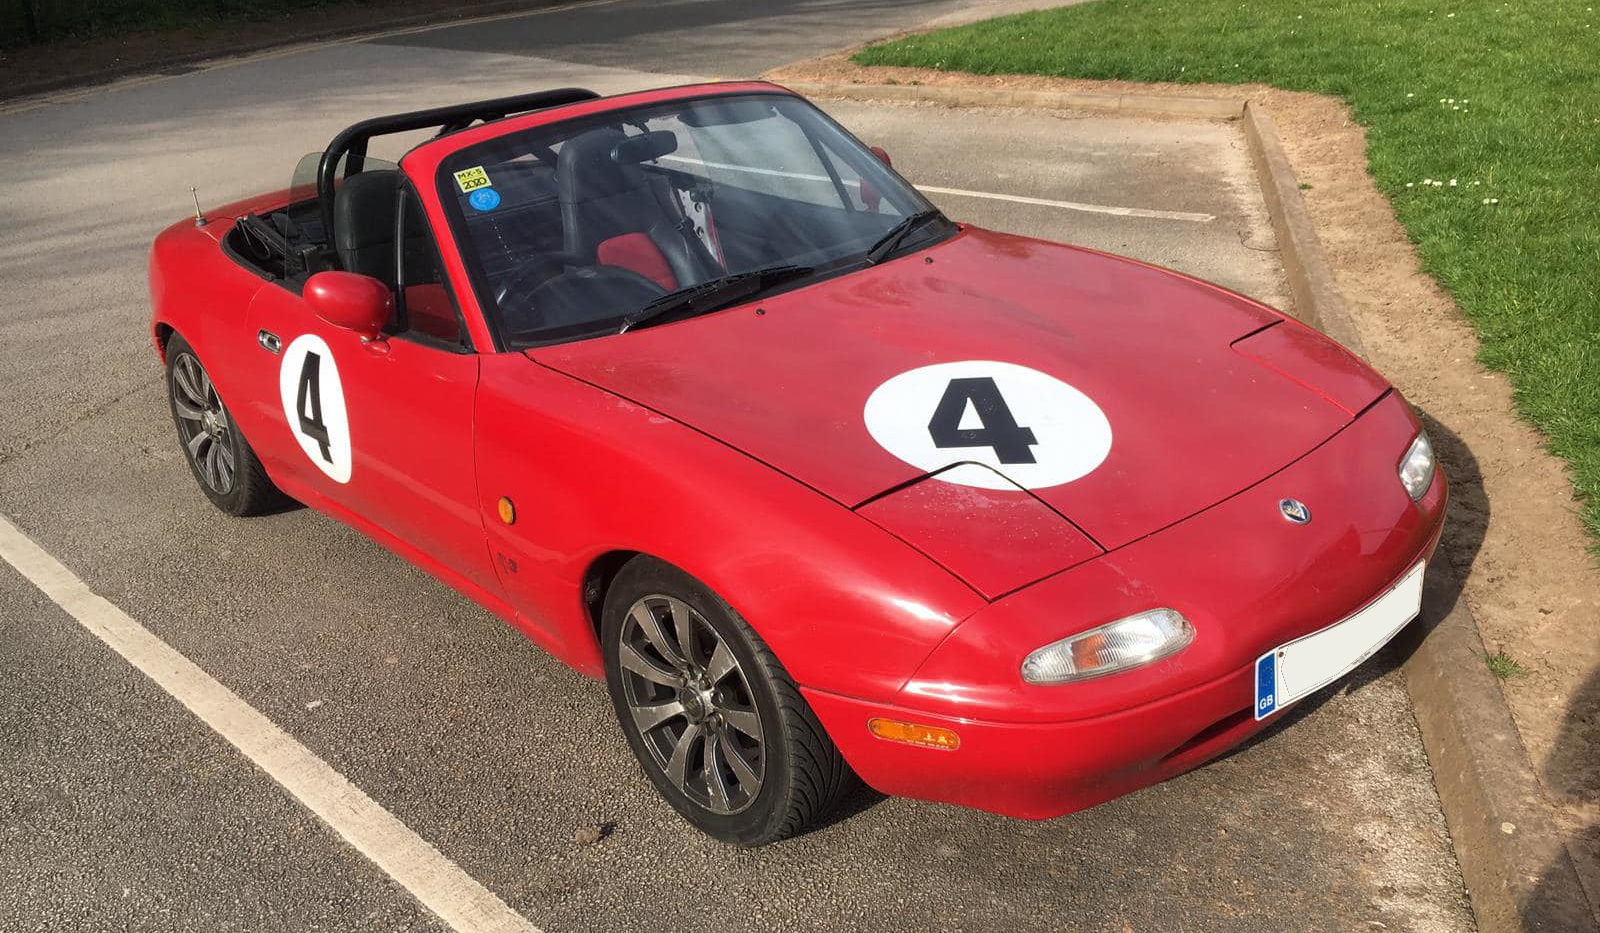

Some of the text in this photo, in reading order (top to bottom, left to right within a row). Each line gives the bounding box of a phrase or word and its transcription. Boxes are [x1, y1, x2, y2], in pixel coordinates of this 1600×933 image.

[457, 168, 482, 179] MX-5
[462, 177, 487, 190] 2020
[297, 351, 334, 465] 4
[928, 377, 1039, 464] 4
[1259, 694, 1273, 710] GB
